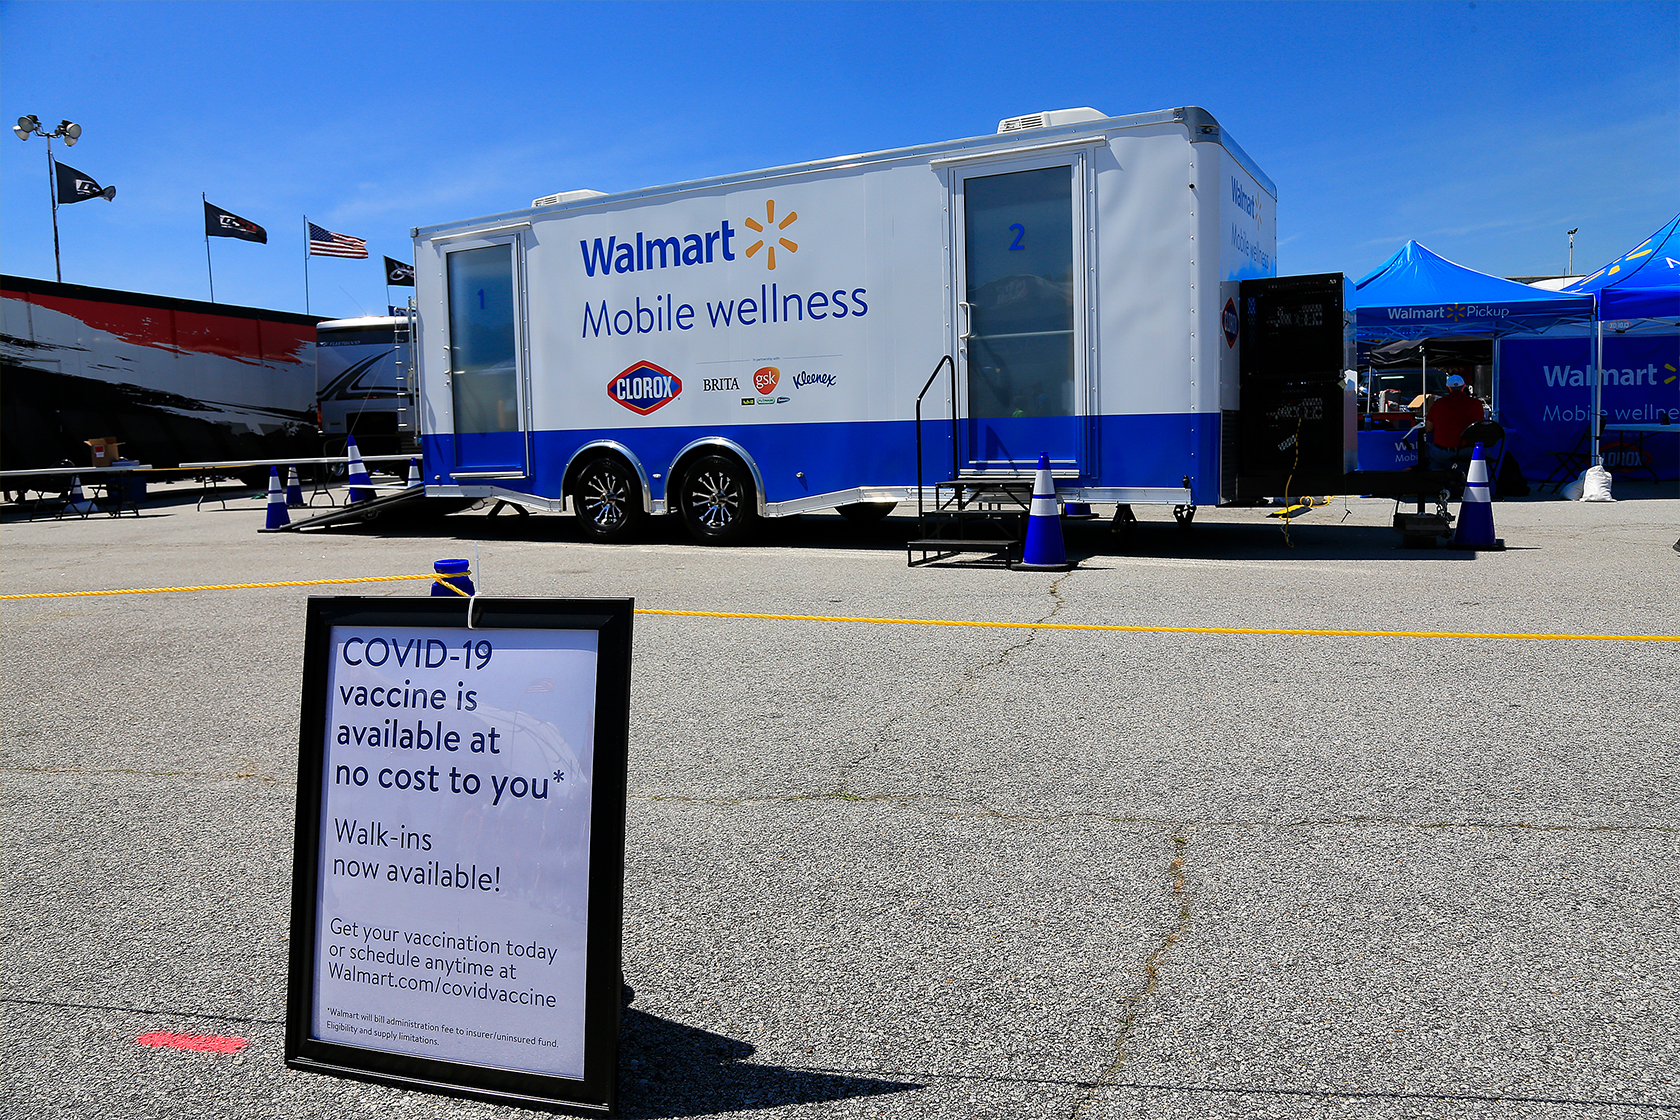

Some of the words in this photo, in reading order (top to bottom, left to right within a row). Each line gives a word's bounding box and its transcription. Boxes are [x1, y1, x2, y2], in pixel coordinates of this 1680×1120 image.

[1231, 175, 1255, 220] Walmart
[580, 220, 735, 277] Walmart
[1009, 223, 1025, 251] 2
[477, 288, 485, 310] 1
[582, 293, 695, 338] Mobile
[706, 282, 868, 328] wellness
[1387, 307, 1445, 320] Walmart
[1466, 305, 1510, 319] Pickup
[616, 375, 673, 400] CLOROX
[702, 377, 740, 391] BRITA
[755, 371, 777, 389] gsk
[792, 371, 836, 389] Kleenex
[1543, 363, 1658, 387] Walmart
[342, 637, 493, 671] COVID-19
[339, 679, 446, 710] vaccine
[456, 681, 477, 712] is
[337, 718, 460, 752] available
[470, 727, 500, 754] at
[336, 765, 369, 786] no
[378, 765, 440, 792] cost
[449, 766, 481, 795] to
[334, 818, 432, 851] Walk-ins
[334, 858, 380, 880] now
[387, 860, 500, 892] available!
[330, 917, 358, 937] Get
[363, 926, 400, 944] your
[404, 931, 500, 954] vaccination
[506, 940, 558, 966] today
[329, 945, 346, 957] or
[350, 944, 420, 968] schedule
[425, 956, 494, 977] anytime
[499, 964, 516, 980] at
[328, 961, 557, 1008] Walmart.com/covidvaccine
[326, 1020, 358, 1035] Eligibility
[359, 1028, 372, 1036] and
[374, 1030, 398, 1041] supply
[398, 1031, 440, 1046] limitations.
[360, 1013, 372, 1022] will
[374, 1014, 385, 1024] bill
[386, 1018, 440, 1032] administration
[441, 1024, 454, 1034] fee
[456, 1027, 464, 1035] to
[466, 1028, 536, 1045] insurer/uninsured
[538, 1037, 559, 1048] fund.
